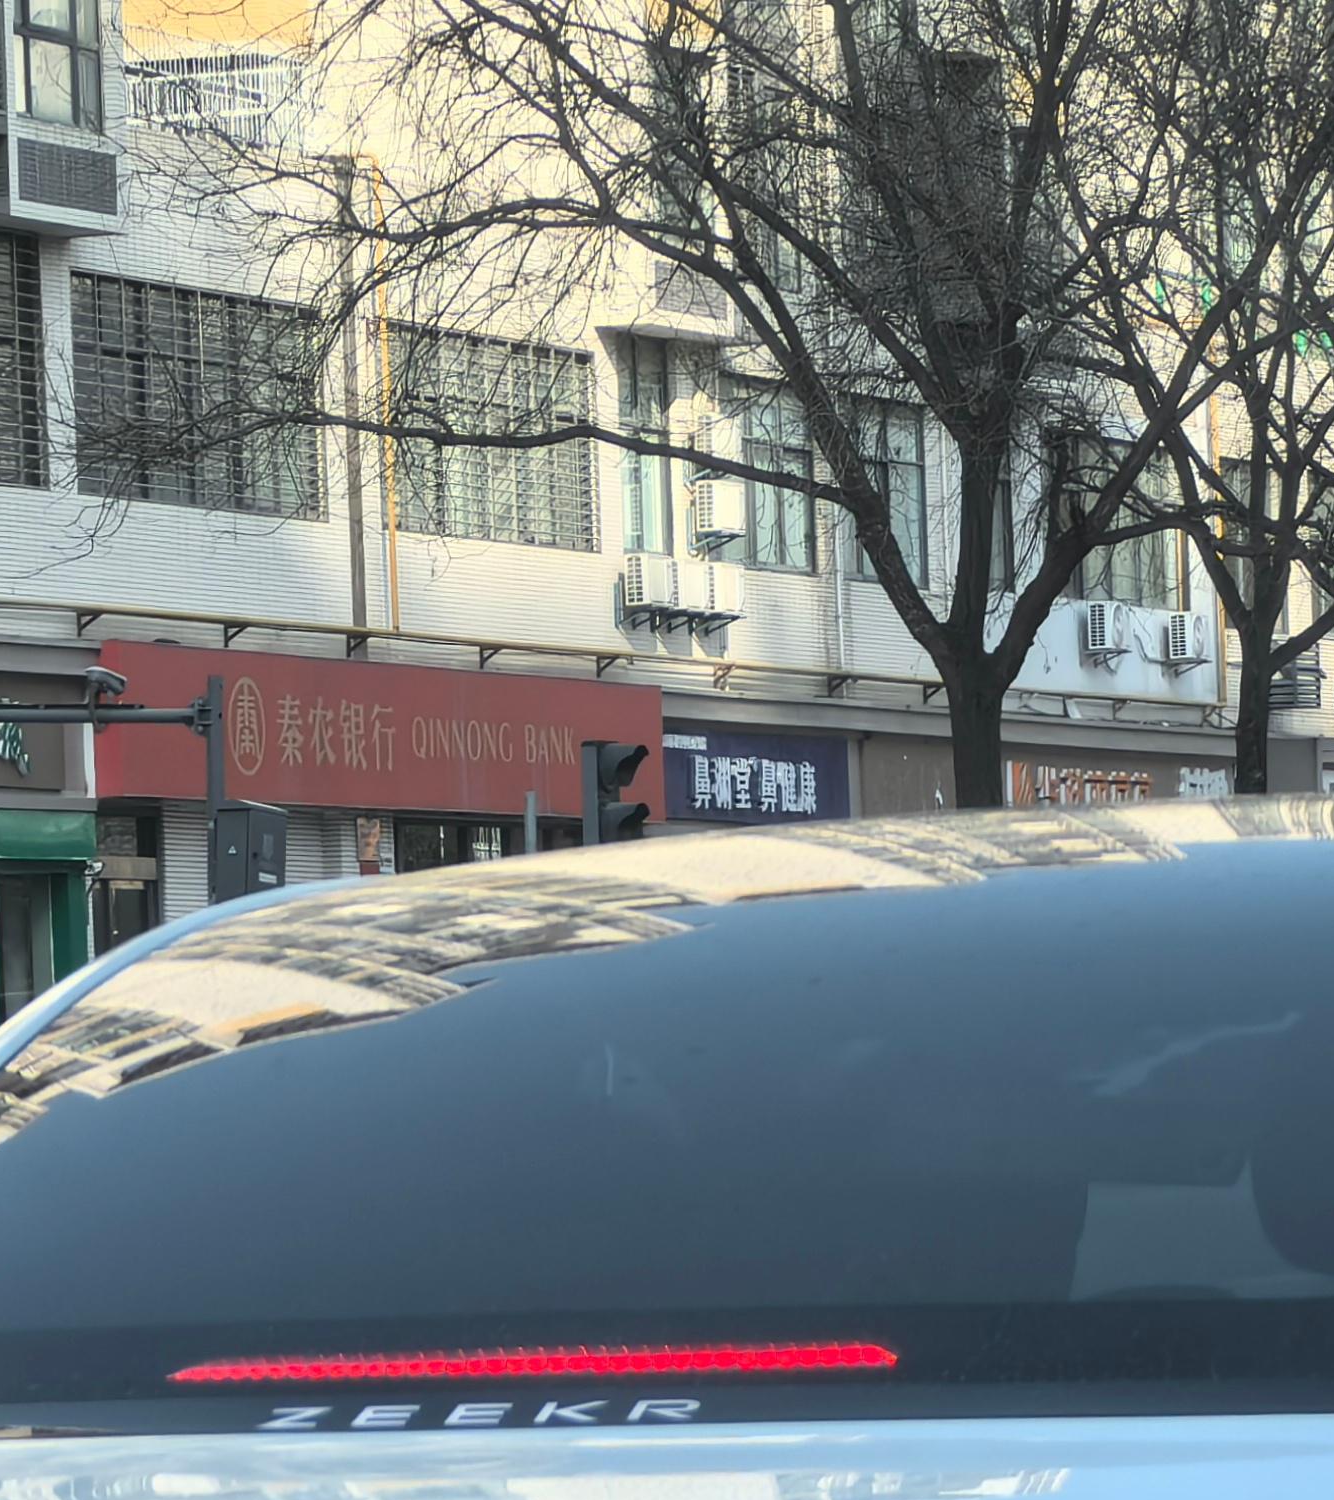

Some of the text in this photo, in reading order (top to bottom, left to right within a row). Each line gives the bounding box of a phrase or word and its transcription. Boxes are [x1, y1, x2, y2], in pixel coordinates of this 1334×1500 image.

[276, 694, 396, 772] 秦农银行
[411, 716, 577, 766] QINNONG BANK
[258, 1397, 701, 1431] ZEEKR
